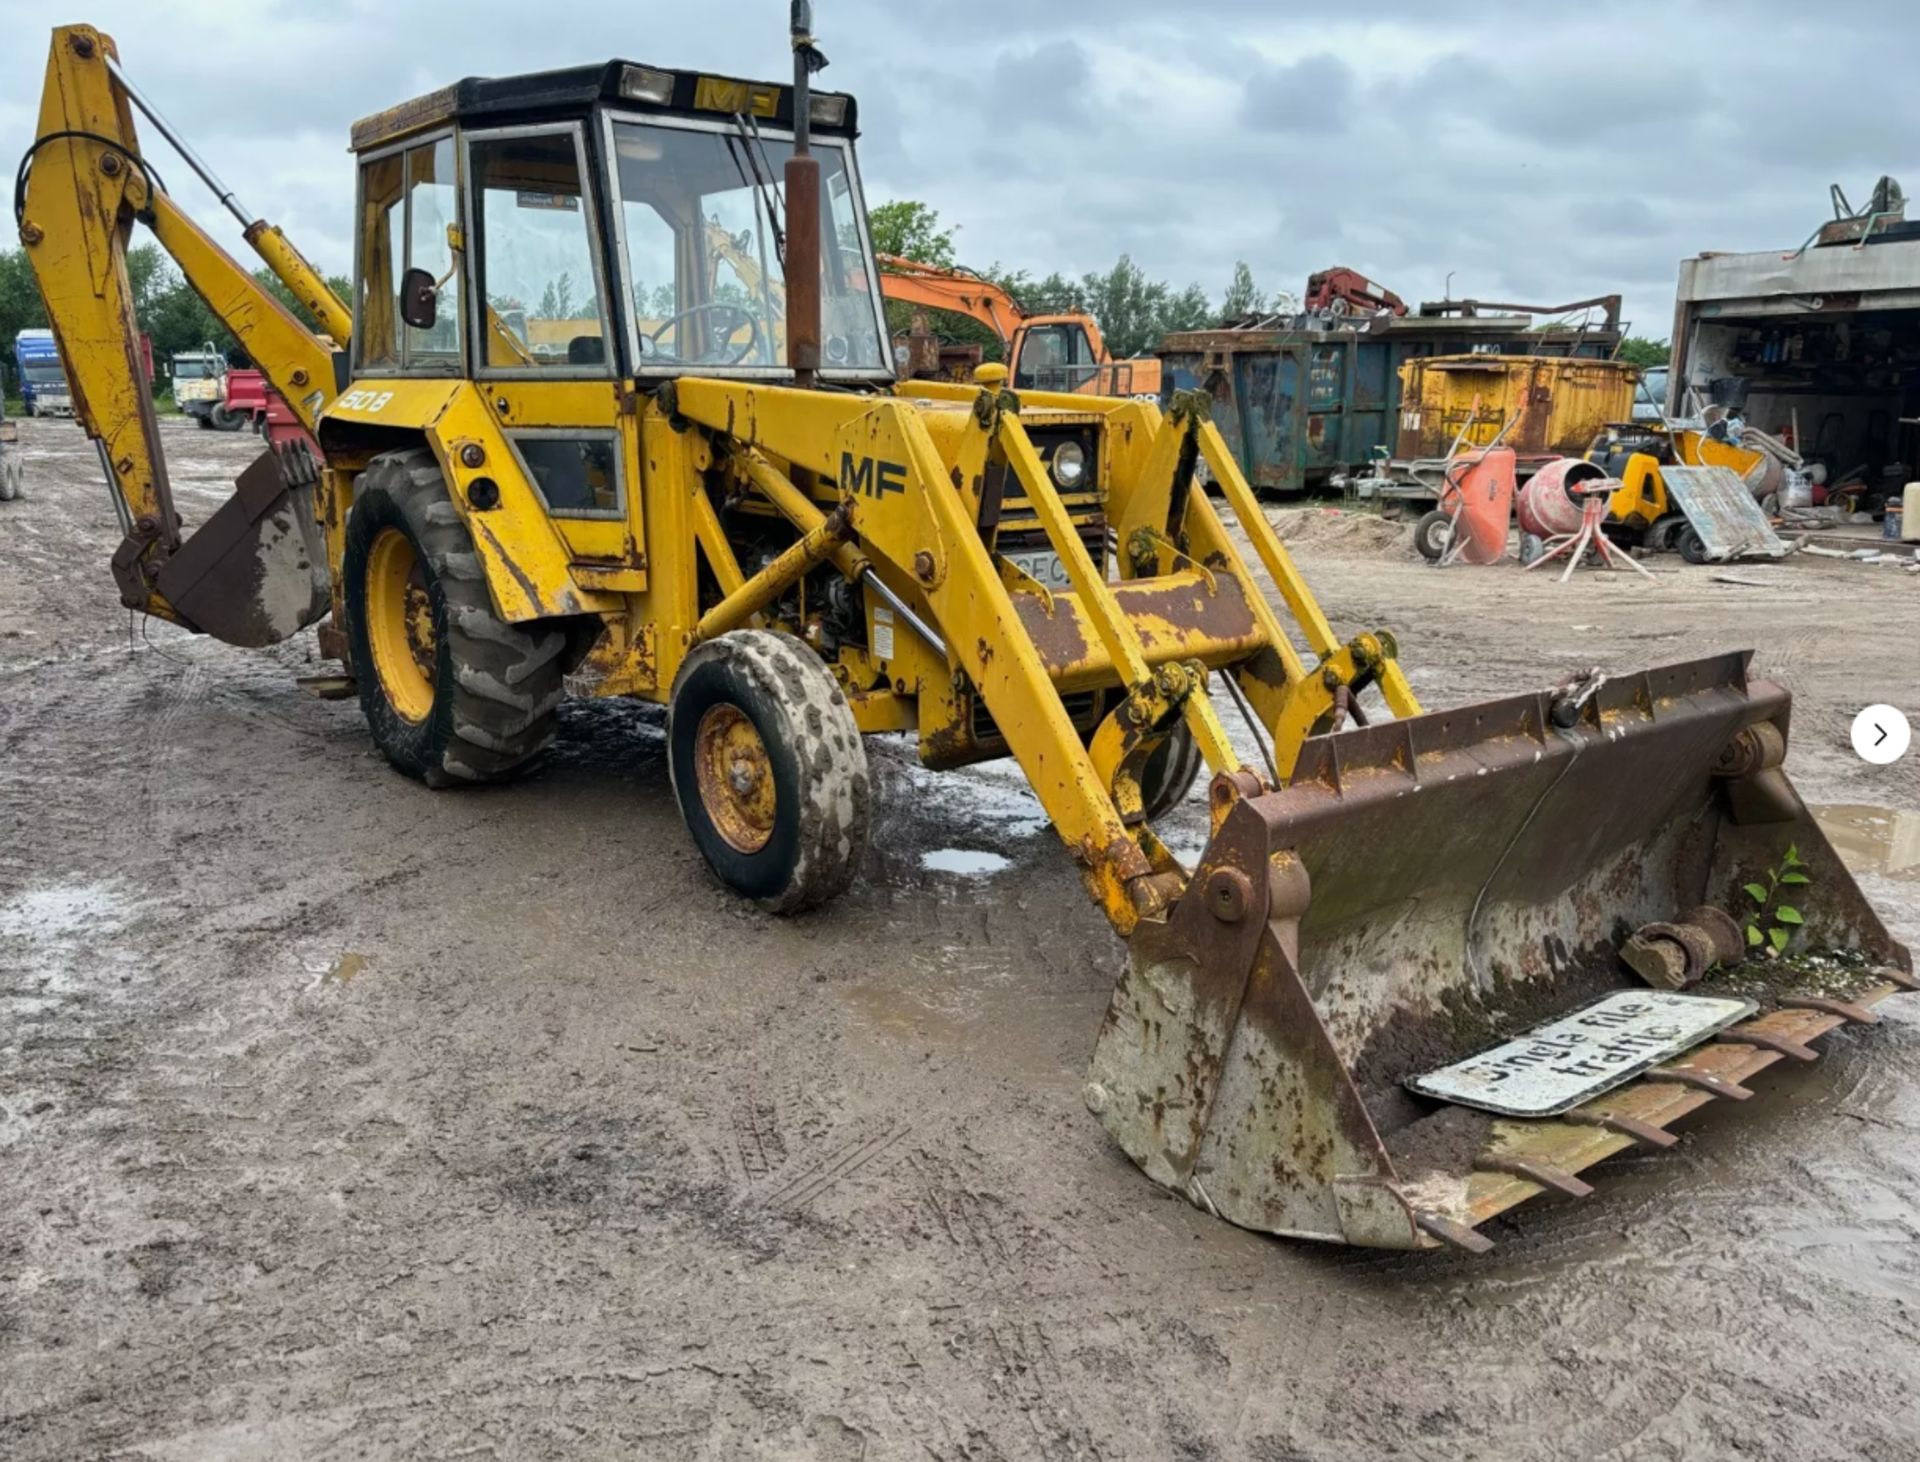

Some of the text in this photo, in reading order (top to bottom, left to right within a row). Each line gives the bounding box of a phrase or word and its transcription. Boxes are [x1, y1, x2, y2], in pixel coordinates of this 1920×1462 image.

[694, 76, 780, 118] MF
[841, 451, 907, 500] MF
[1578, 1003, 1653, 1028] file
[1550, 1024, 1682, 1076] traffic
